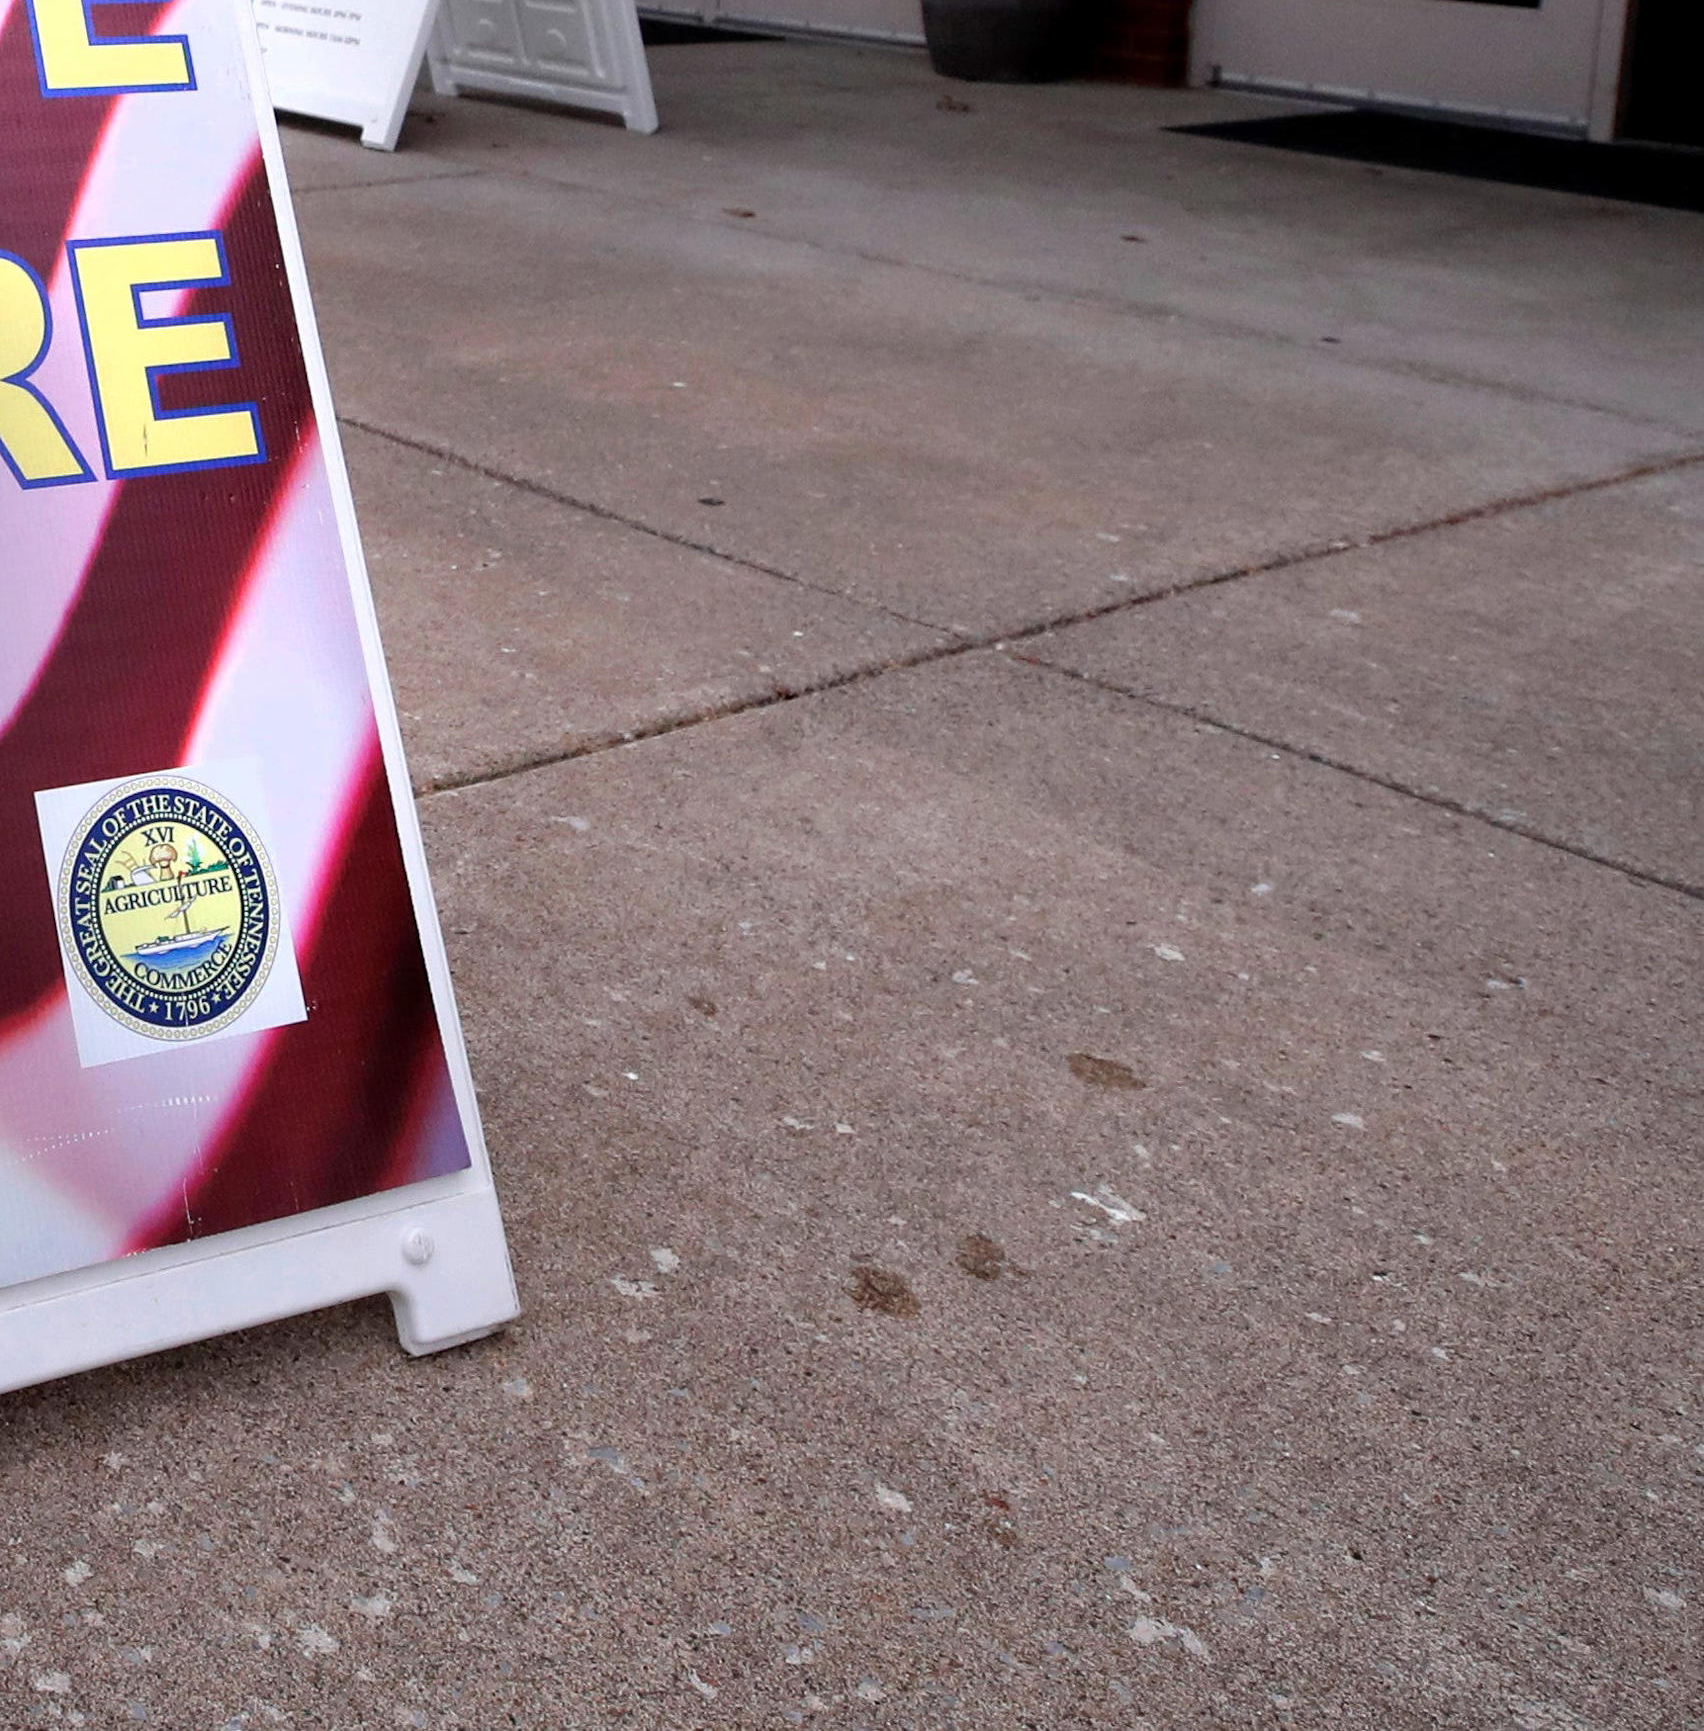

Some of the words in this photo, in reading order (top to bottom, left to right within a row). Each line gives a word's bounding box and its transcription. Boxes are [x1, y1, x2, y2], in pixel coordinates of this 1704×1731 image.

[102, 809, 128, 838] OF
[125, 794, 172, 817] THE
[174, 795, 233, 843] STATE
[140, 826, 176, 848] XVI
[228, 837, 254, 868] OF
[76, 838, 109, 896] SEAL
[103, 875, 233, 916] AGRICULTURE
[73, 896, 111, 977] GREAT
[222, 869, 265, 1001] TENNESSEE
[133, 941, 233, 991] COMMERCE
[105, 971, 146, 1014] THE
[163, 995, 212, 1022] 1796
